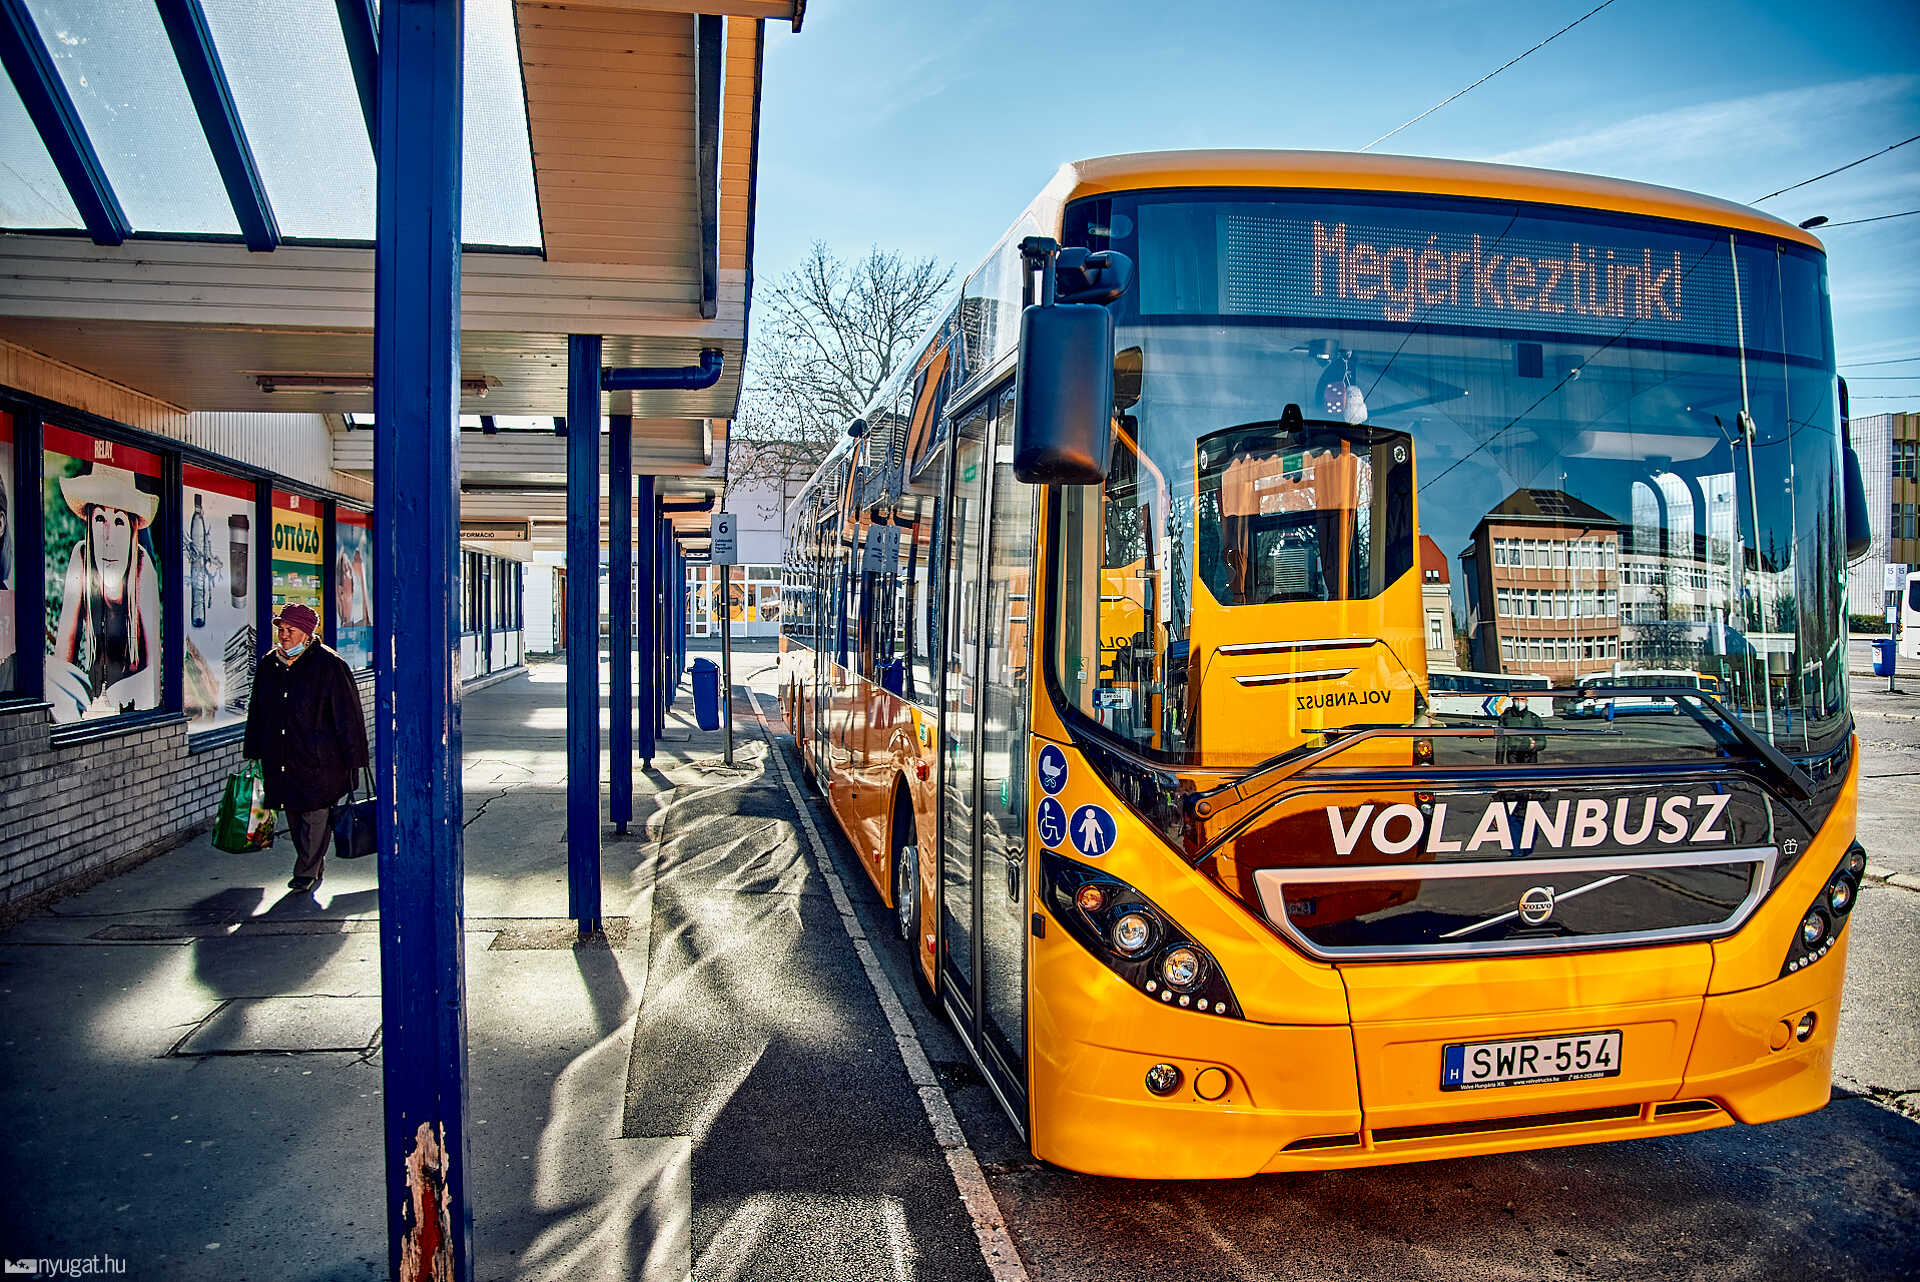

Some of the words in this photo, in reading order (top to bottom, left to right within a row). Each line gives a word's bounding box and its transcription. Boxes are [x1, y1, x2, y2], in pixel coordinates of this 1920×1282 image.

[1313, 220, 1682, 322] Megérkeztünk!
[94, 440, 113, 459] RELAY
[271, 522, 319, 554] OTTÓZÓ
[719, 521, 728, 534] 6
[1326, 794, 1731, 855] VOLÁNBUSZ
[1450, 1068, 1459, 1080] H
[1472, 1038, 1611, 1079] SWR-554
